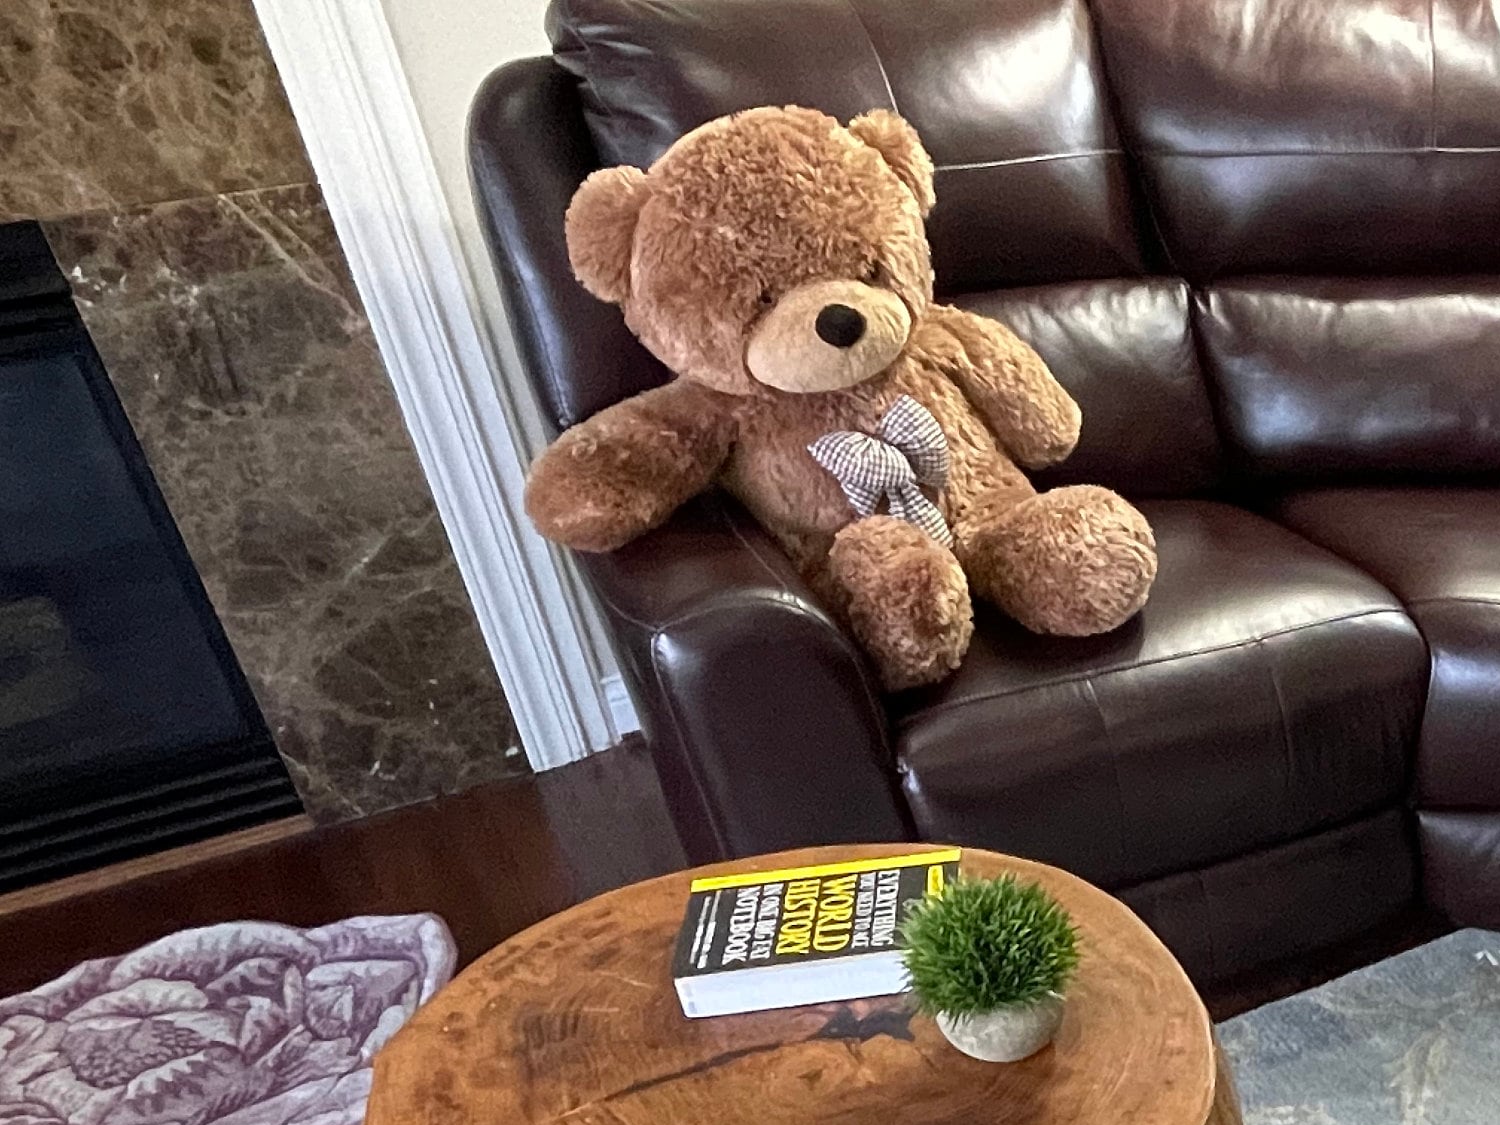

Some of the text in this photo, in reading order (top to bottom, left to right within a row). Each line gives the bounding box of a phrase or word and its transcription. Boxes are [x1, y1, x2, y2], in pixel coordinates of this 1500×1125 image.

[722, 885, 762, 965] NOTEBOOK
[750, 883, 784, 960] IN ONE BIG FAT
[775, 879, 821, 955] HISTORY
[812, 874, 858, 951] WORLD
[854, 918, 872, 932] TO
[855, 891, 874, 917] NEED
[871, 869, 900, 946] EVERYTHING
